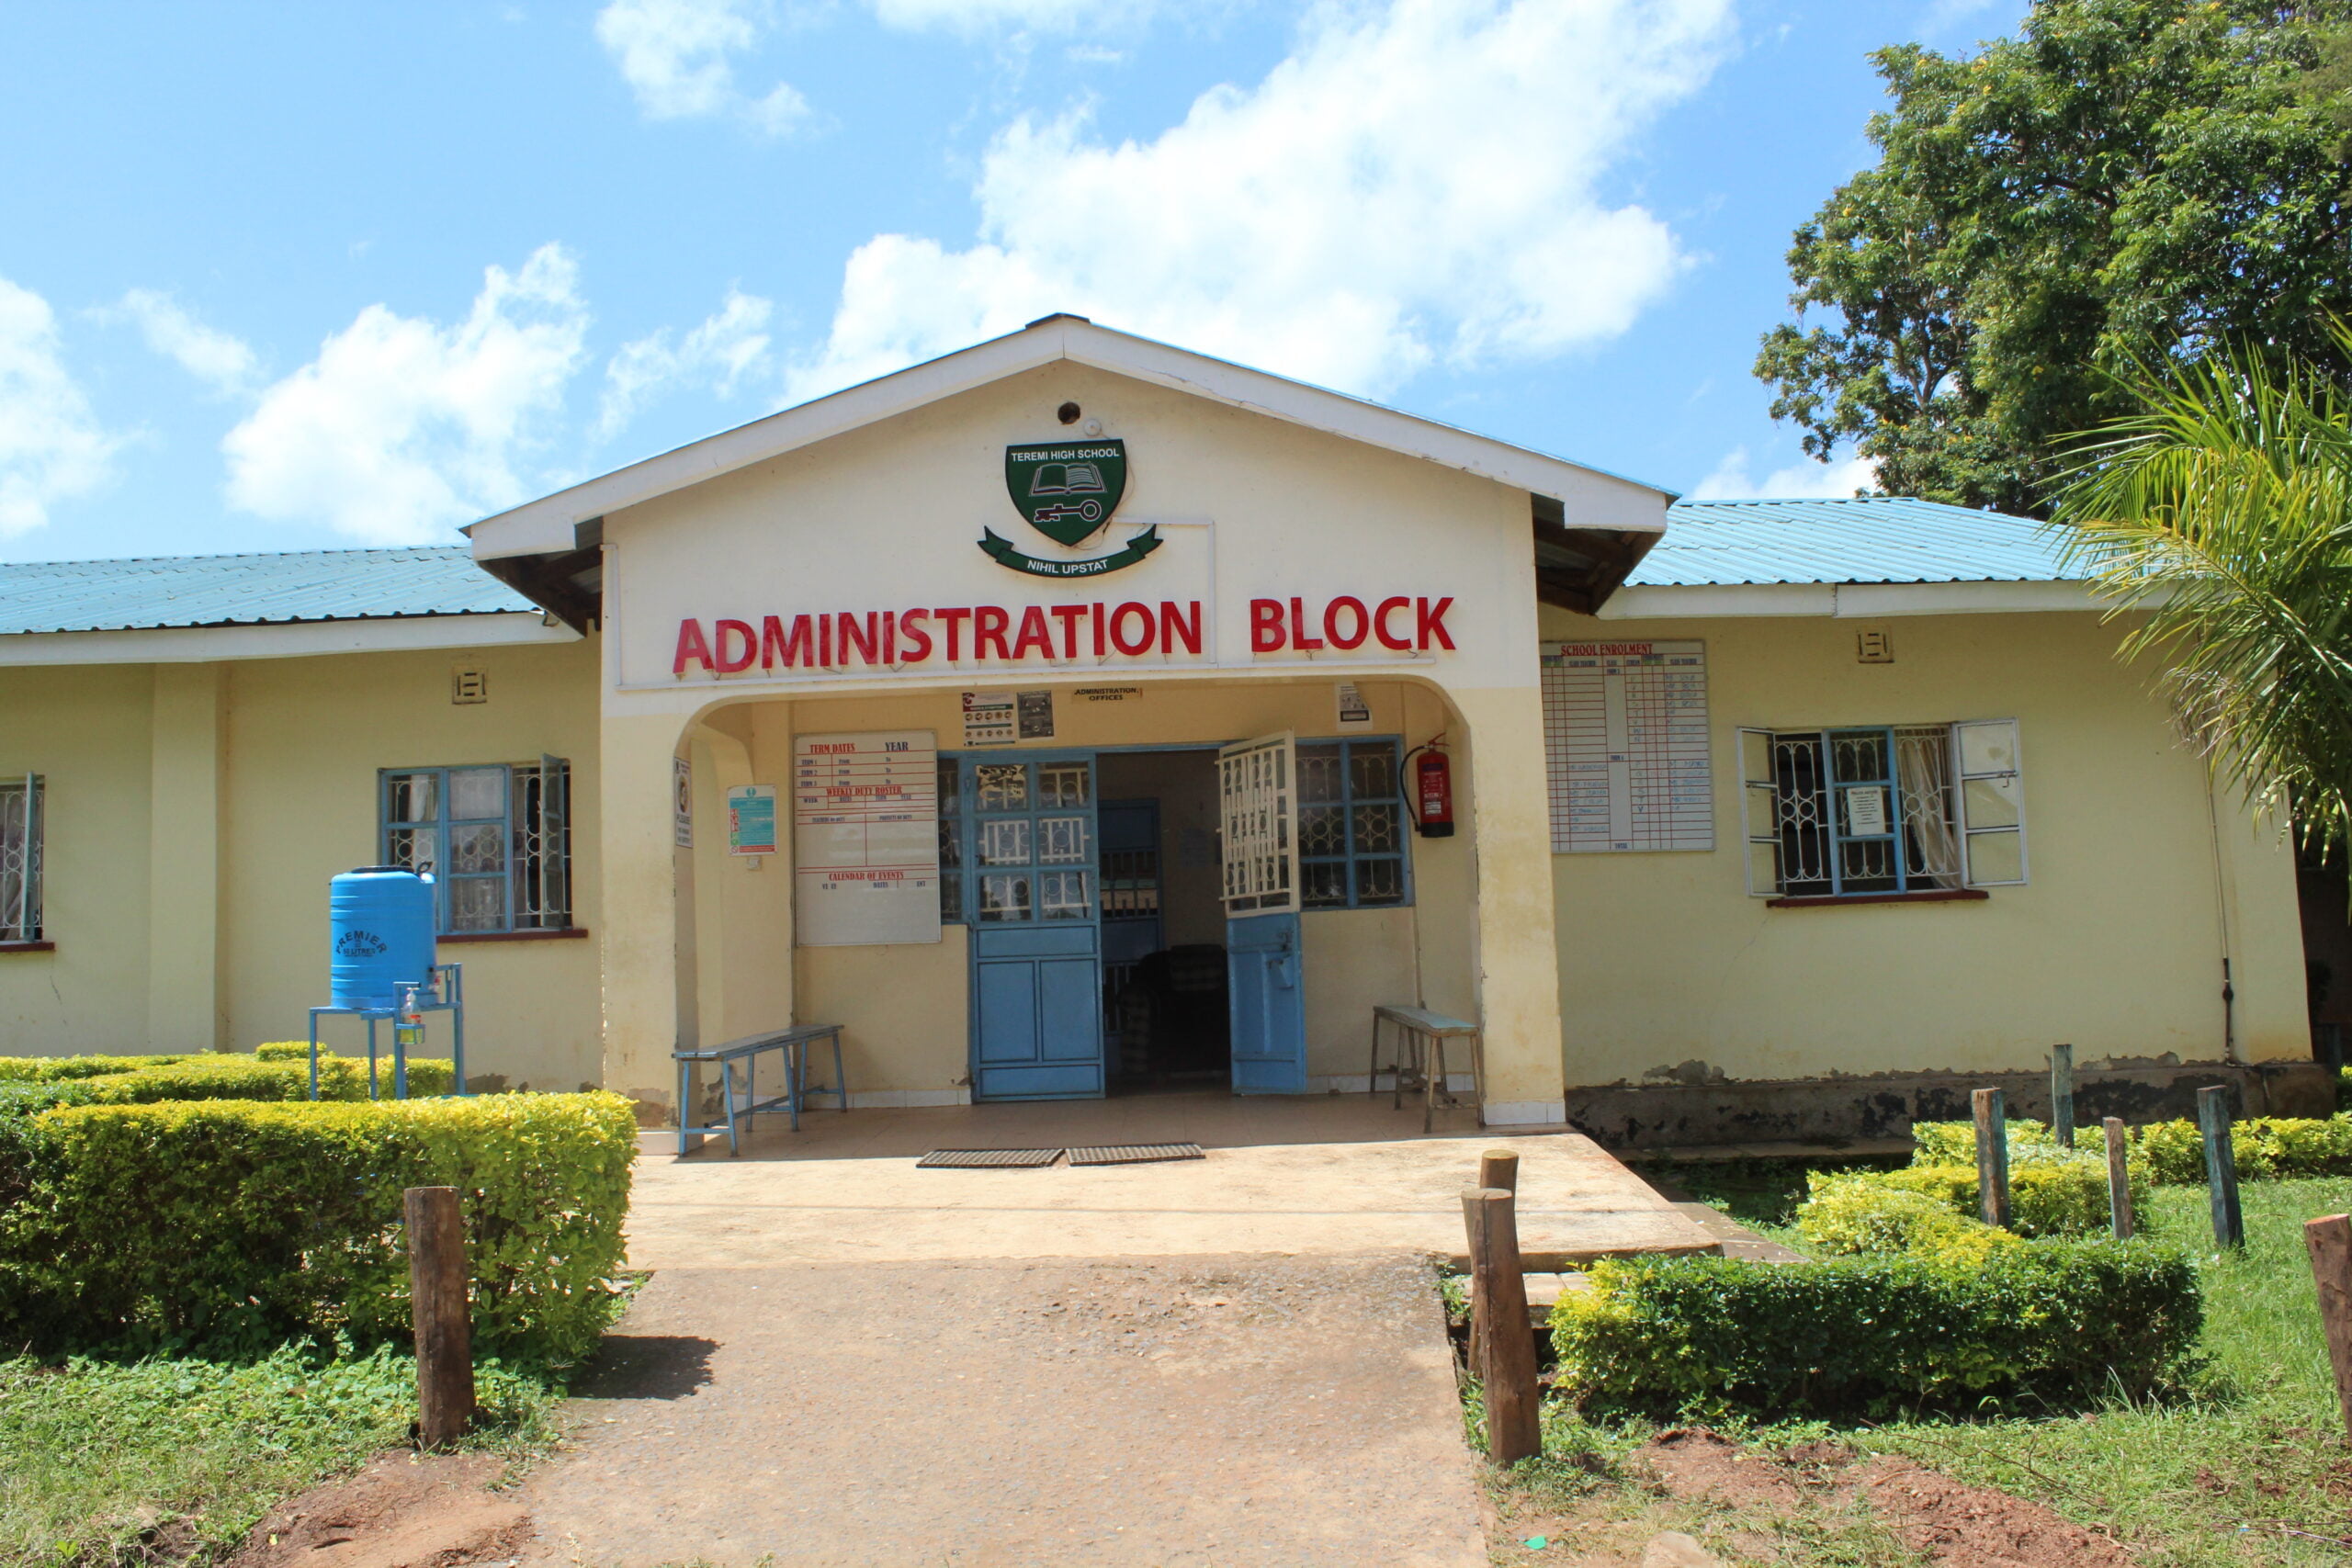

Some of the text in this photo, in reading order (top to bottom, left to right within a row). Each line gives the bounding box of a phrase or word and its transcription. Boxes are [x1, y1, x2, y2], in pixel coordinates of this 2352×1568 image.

[1012, 447, 1120, 462] TEREMI HIGH SCHOOL
[1027, 558, 1109, 574] NIHIL UPSTAT
[673, 595, 1456, 674] ADMINISTRATION BLOCK
[1561, 643, 1653, 656] SCHOOL ENROLMENT
[809, 742, 855, 753] TERM DATES
[885, 741, 909, 751] YEAR
[826, 785, 902, 796] WEEKLY DUTY ROSTER
[829, 871, 904, 881] CALENDAR OF EVENTS
[336, 930, 388, 954] PREMIER
